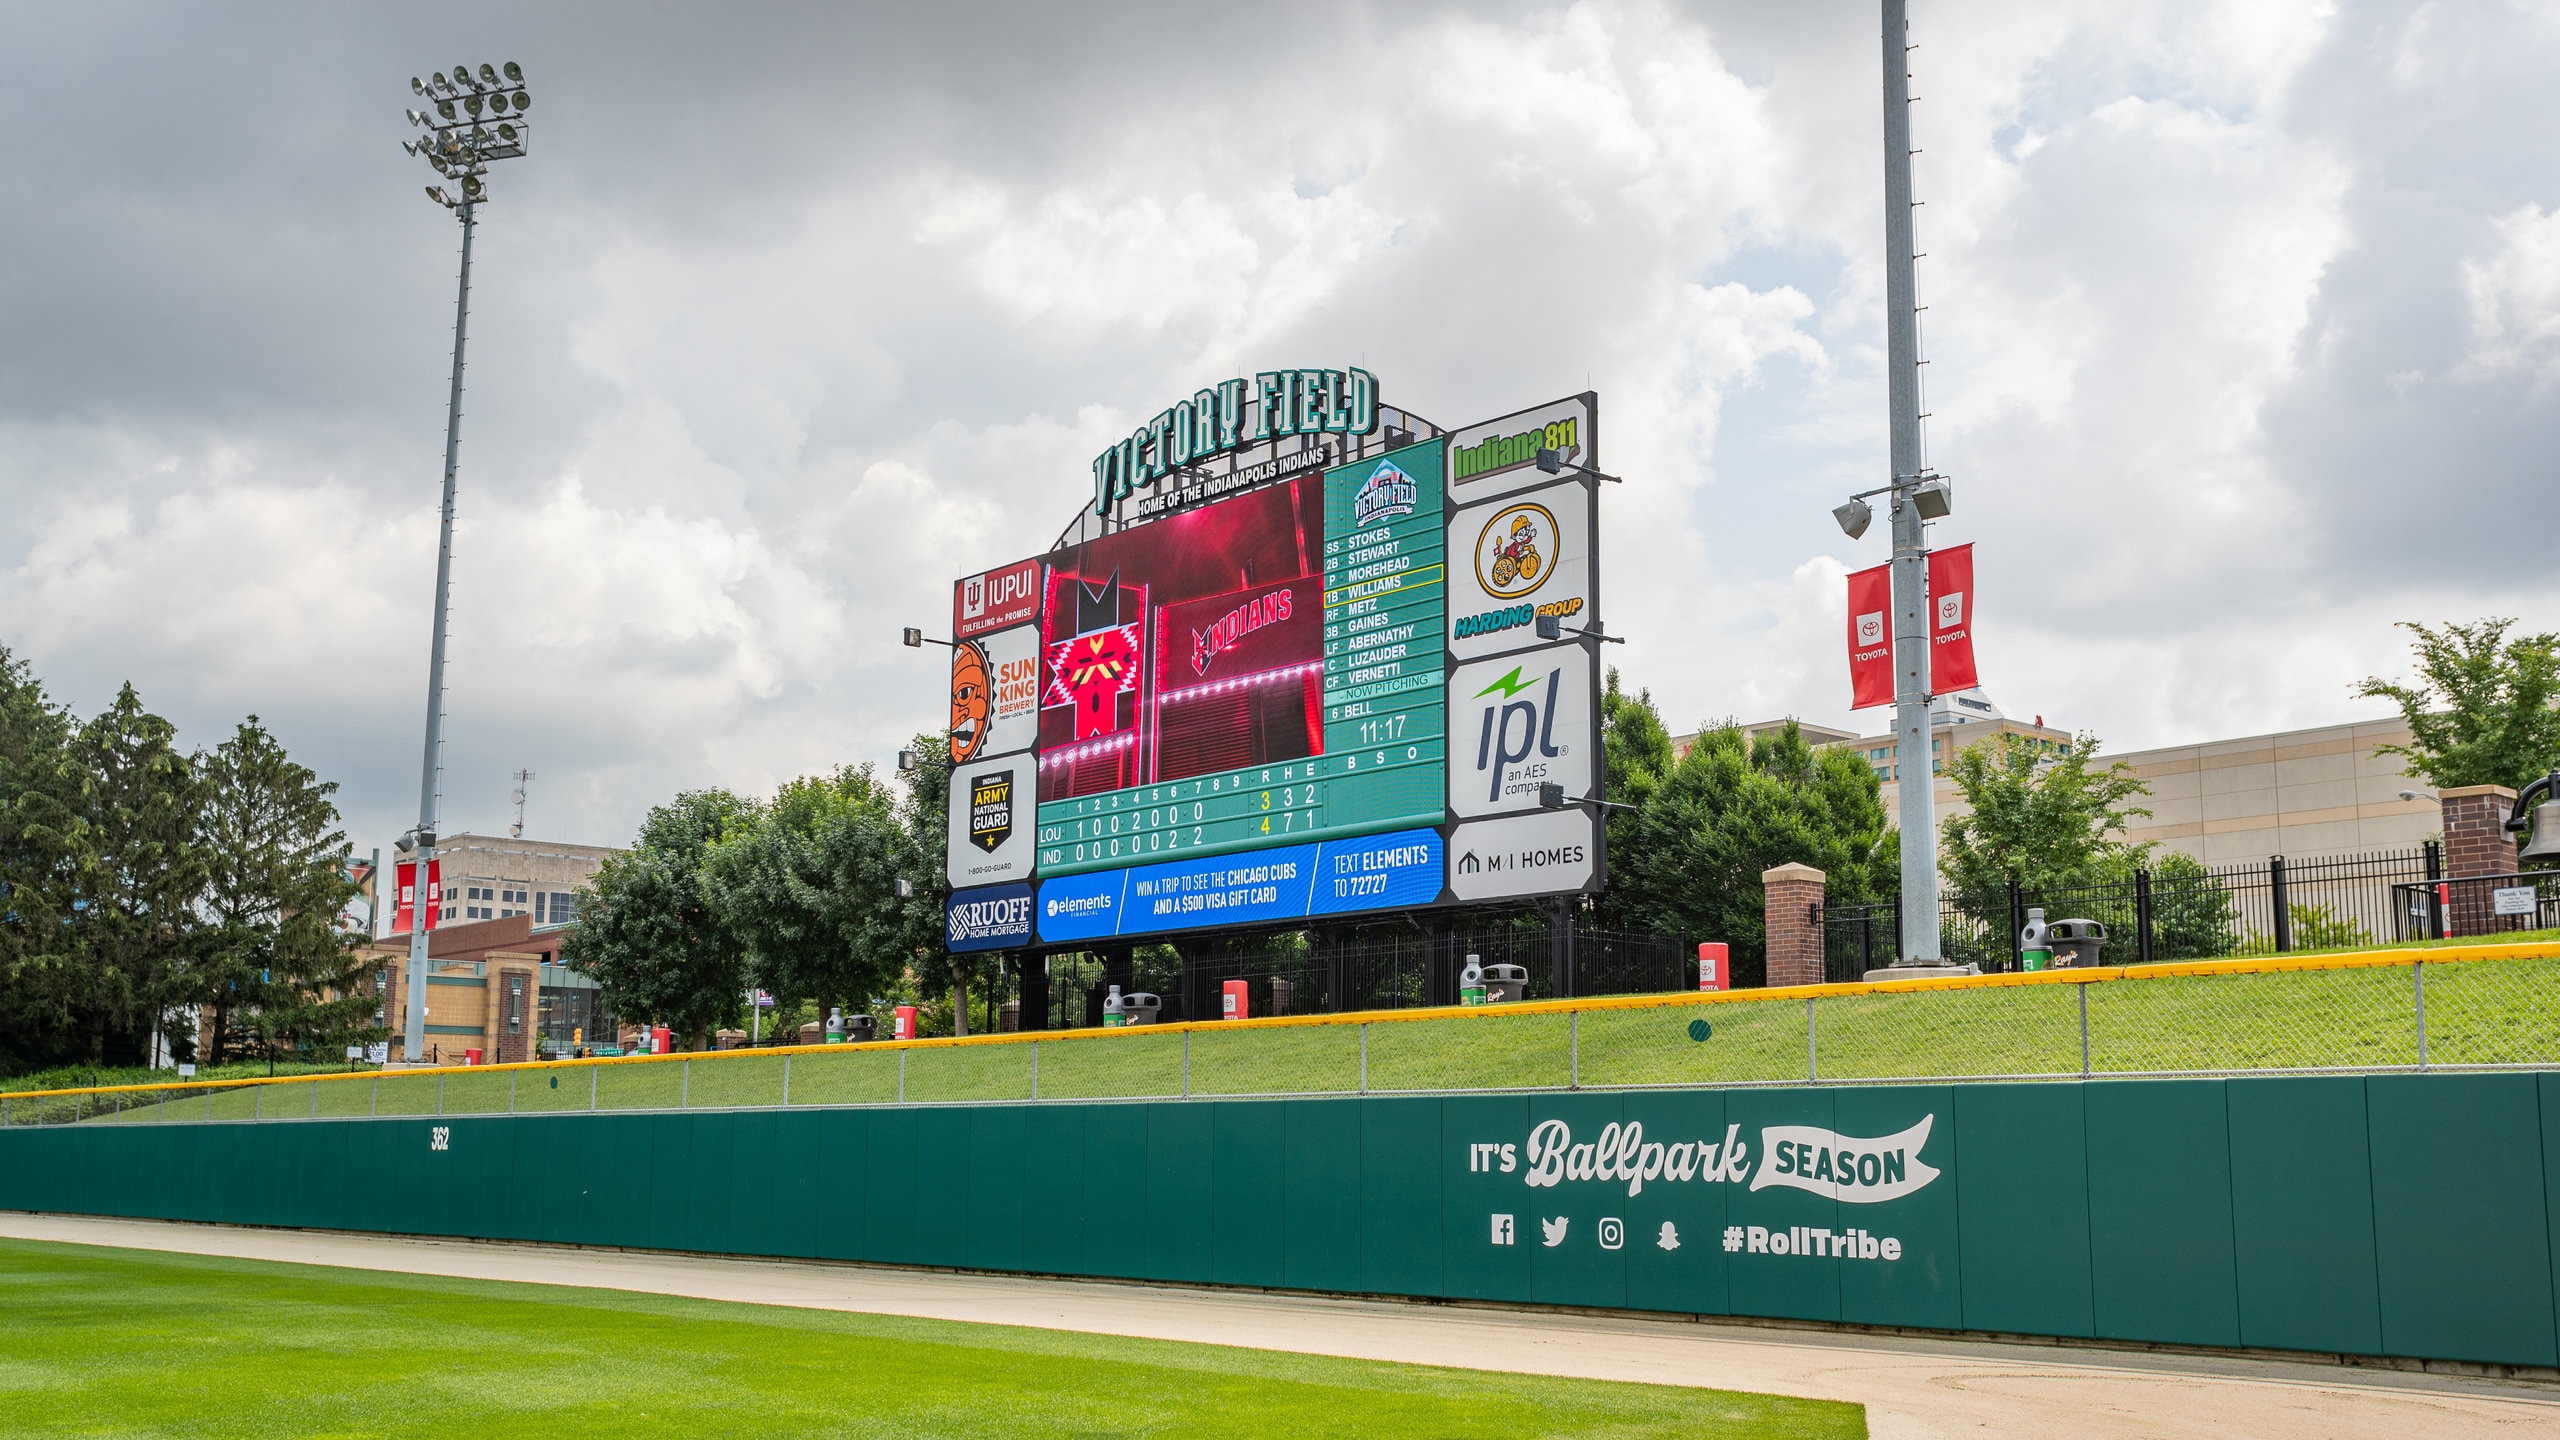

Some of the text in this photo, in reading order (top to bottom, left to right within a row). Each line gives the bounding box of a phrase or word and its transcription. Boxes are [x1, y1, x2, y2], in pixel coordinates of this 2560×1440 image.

[1093, 366, 1379, 515] VICTORY FIELD
[1138, 447, 1324, 516] HOME OF THE INDIANAPOLIS INDIANS
[1354, 484, 1417, 520] VICTORY FIELD
[1364, 507, 1406, 521] INDIANAPOLIS
[1326, 527, 1391, 554] SS STOKES
[1326, 541, 1400, 570] 2B STEWART
[1329, 556, 1410, 586] P MOREHEAD
[989, 568, 1032, 607] IUPUI
[1326, 576, 1401, 604] 1B WILLIAMS
[962, 617, 995, 634] FULFILLING
[1005, 607, 1031, 622] PROMISE
[1326, 598, 1377, 621] RF METZ
[1535, 597, 1583, 619] GROUP
[1326, 612, 1388, 638] 3B GAINES
[1935, 630, 1967, 645] TOYOTA
[1326, 624, 1414, 655] LF ABERNATHY
[1328, 644, 1406, 670] C LUZAUDER
[1855, 648, 1888, 662] TOYOTA
[1000, 656, 1036, 685] SUN
[1326, 662, 1400, 688] CF VERNETTI
[1000, 679, 1035, 704] KING
[1346, 674, 1428, 700] NOW PITCHING
[999, 698, 1035, 715] BREWERY
[1332, 701, 1373, 719] 6 BELL
[1360, 714, 1406, 744] 11:17
[1347, 746, 1417, 769] B S O
[982, 775, 1002, 786] INDIANA
[1508, 763, 1547, 781] an AES
[975, 786, 1009, 806] ARMY
[1078, 763, 1314, 813] 1 2 3 4 5 6 7 8 9 R H E
[1505, 780, 1554, 797] compa
[973, 812, 1008, 830] GUARD
[974, 802, 1008, 816] NATIONAL
[1040, 784, 1314, 843] LOU 1 0 0 2 0 0 0 3 3 2
[1043, 809, 1313, 865] IND 0 0 0 0 0 2 2 4 7 1
[1334, 845, 1428, 874] TEXT ELEMENTS
[1522, 845, 1584, 869] HOMES
[1136, 862, 1297, 897] WIN A TRIP TO SEE THE CHICAGO CUBS
[1334, 873, 1387, 897] TO 72727
[970, 896, 1030, 927] RUOFF
[1058, 893, 1112, 913] elements
[1153, 886, 1277, 915] AND A $500 VISA GIFT CARD
[970, 923, 1029, 939] HOME MORTGAGE
[431, 1126, 449, 1150] 362
[1470, 1119, 1906, 1198] IT'S Ballpark SEASON
[1722, 1225, 1902, 1261] #RollTribe
